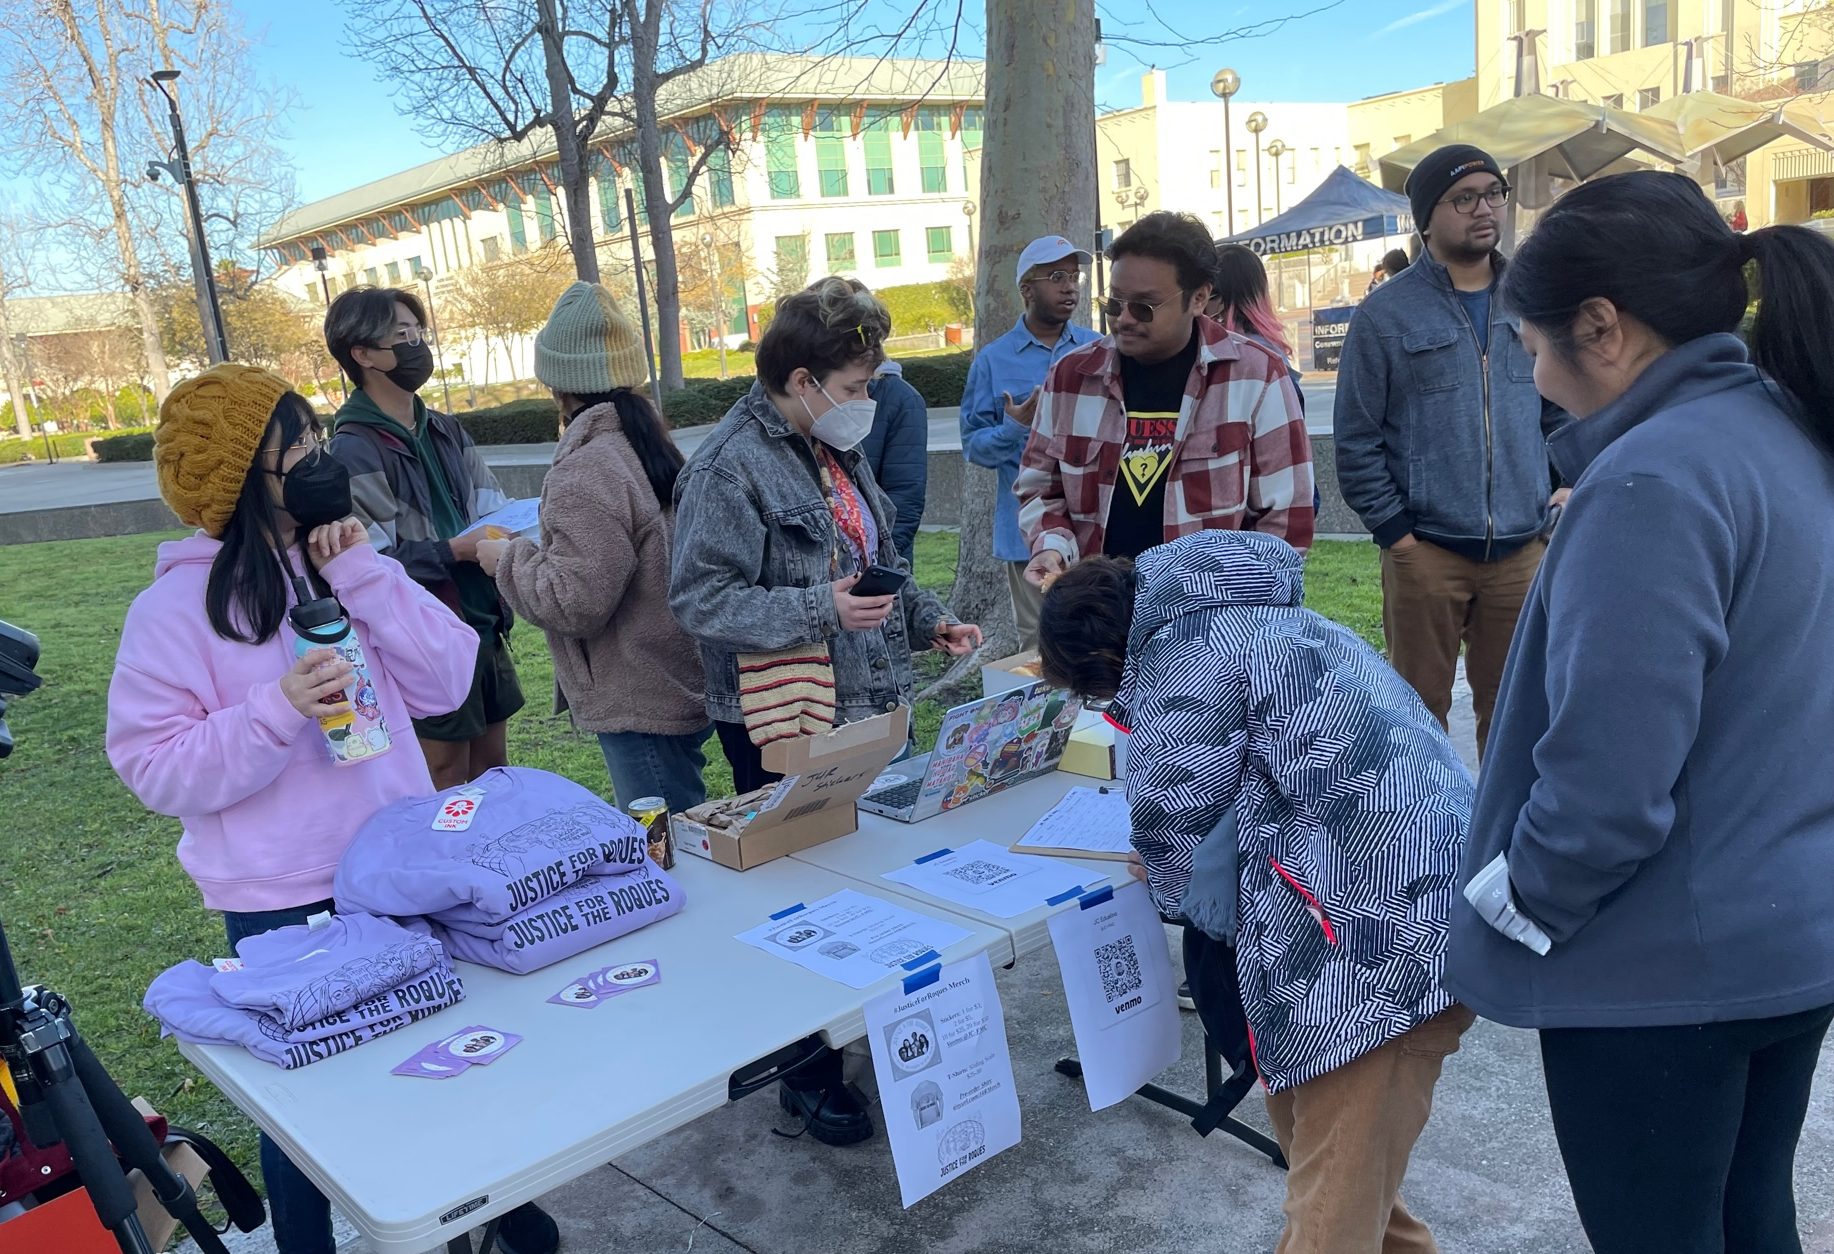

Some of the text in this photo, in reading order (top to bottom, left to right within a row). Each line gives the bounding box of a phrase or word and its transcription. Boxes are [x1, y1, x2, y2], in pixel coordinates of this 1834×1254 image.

[1127, 419, 1176, 437] UESS
[506, 860, 568, 912] JUSTICE
[568, 847, 599, 869] FOR
[574, 895, 608, 914] FOR
[607, 878, 670, 917] ROQUES
[507, 904, 579, 949] JUSTICE
[580, 907, 612, 928] THE
[948, 977, 970, 990] Merch
[354, 1000, 394, 1020] THE
[1114, 995, 1143, 1015] venmo
[940, 1159, 958, 1178] JUSTICE
[968, 1145, 986, 1161] ROQUES
[446, 1200, 483, 1220] LIFETIME
